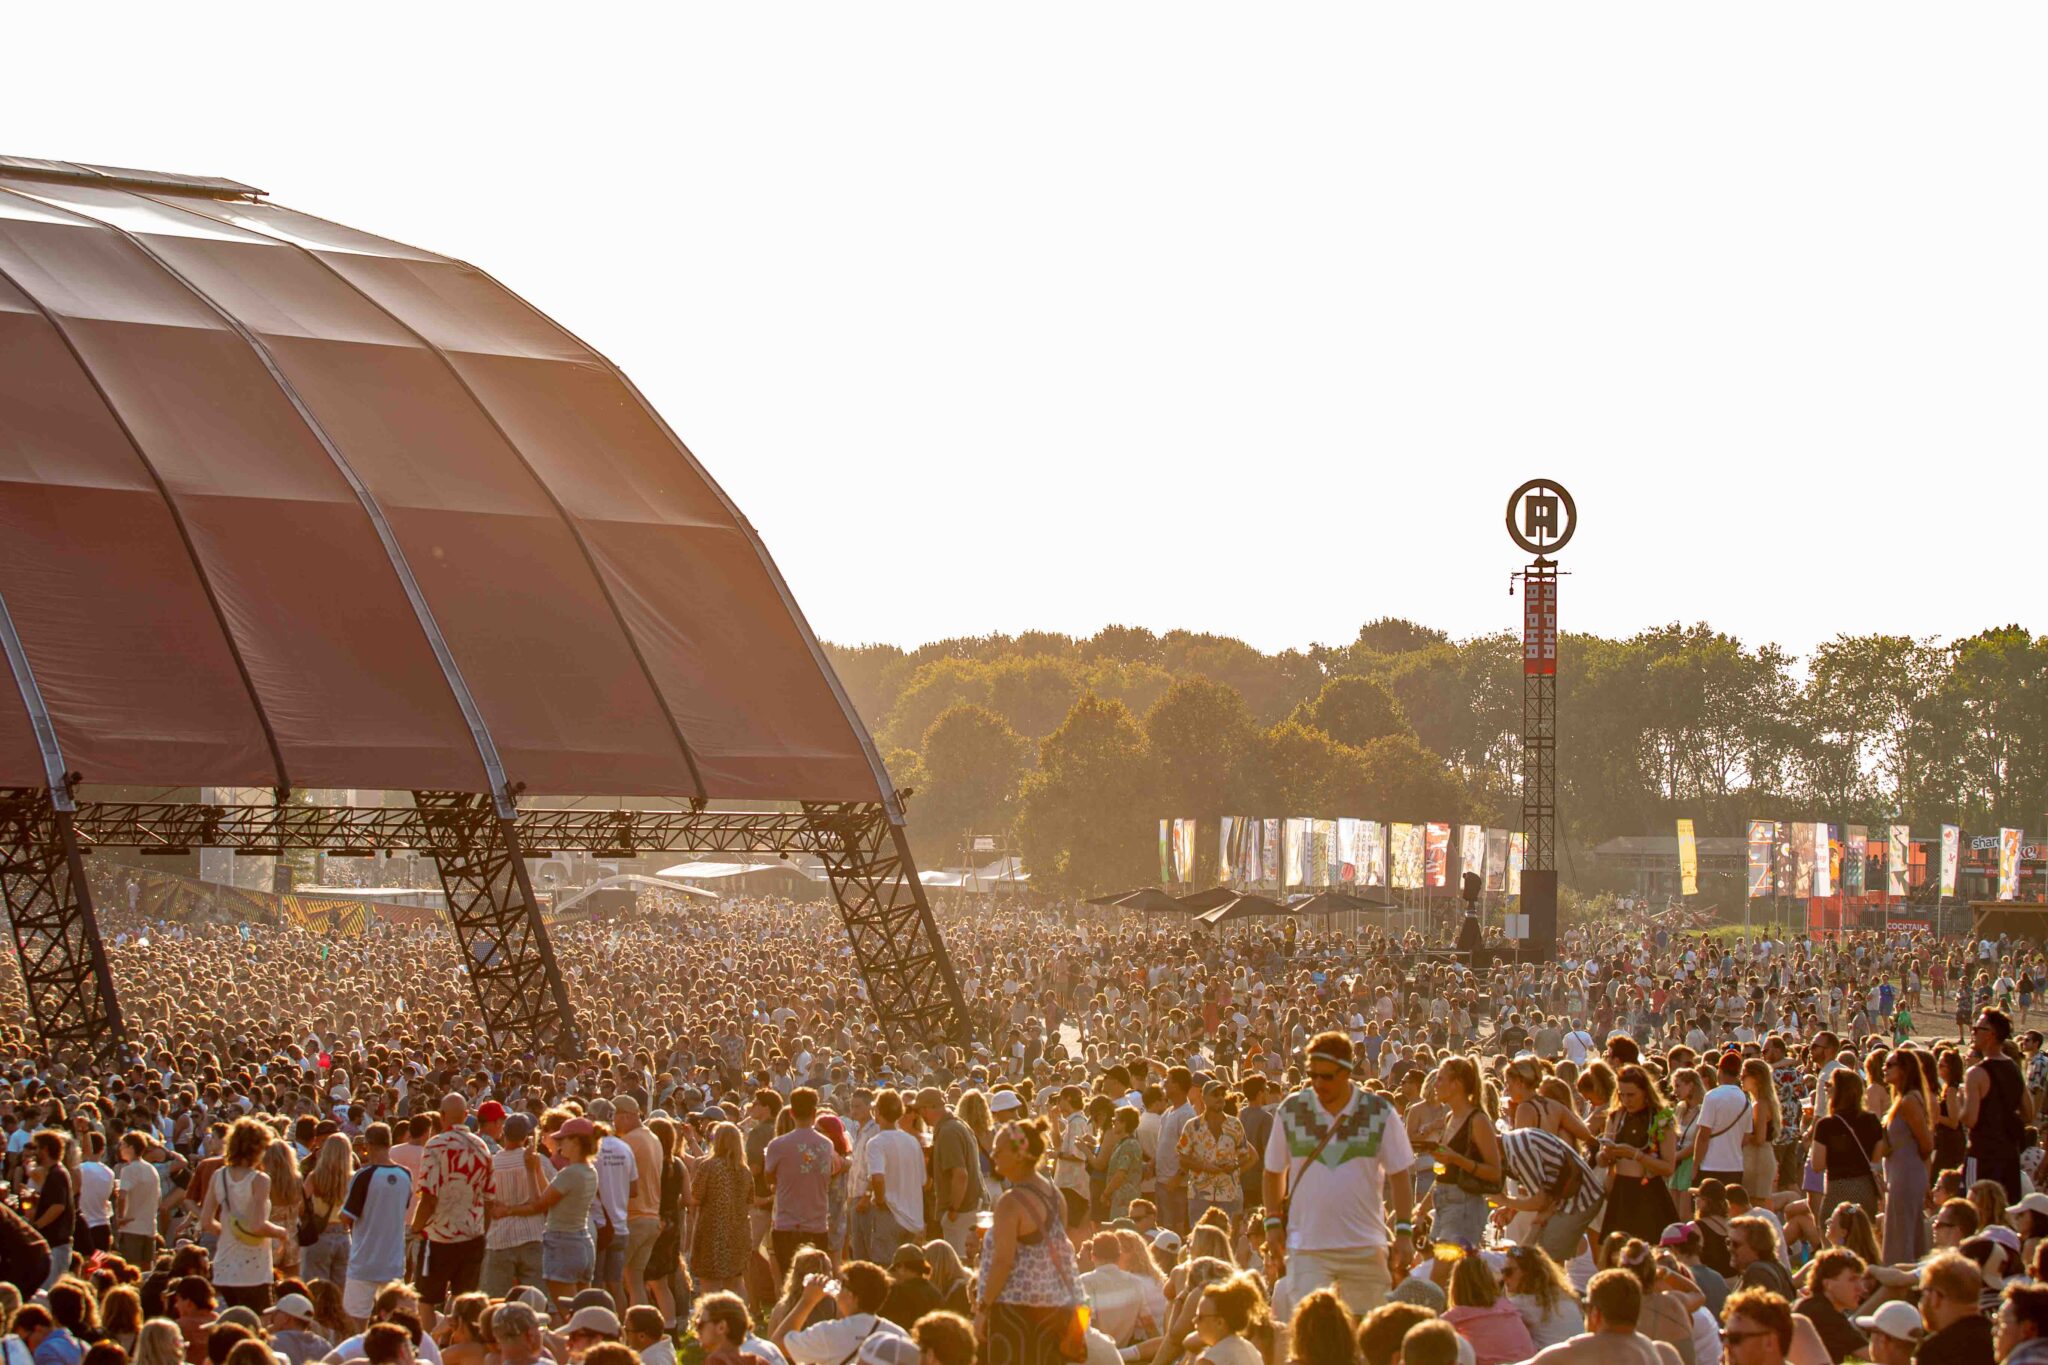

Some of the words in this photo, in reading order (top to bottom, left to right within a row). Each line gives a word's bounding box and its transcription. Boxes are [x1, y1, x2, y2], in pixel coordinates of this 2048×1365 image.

[1526, 584, 1539, 659] ALPHA
[1543, 584, 1555, 659] ALPHA
[1887, 922, 1930, 931] COCKTAILS
